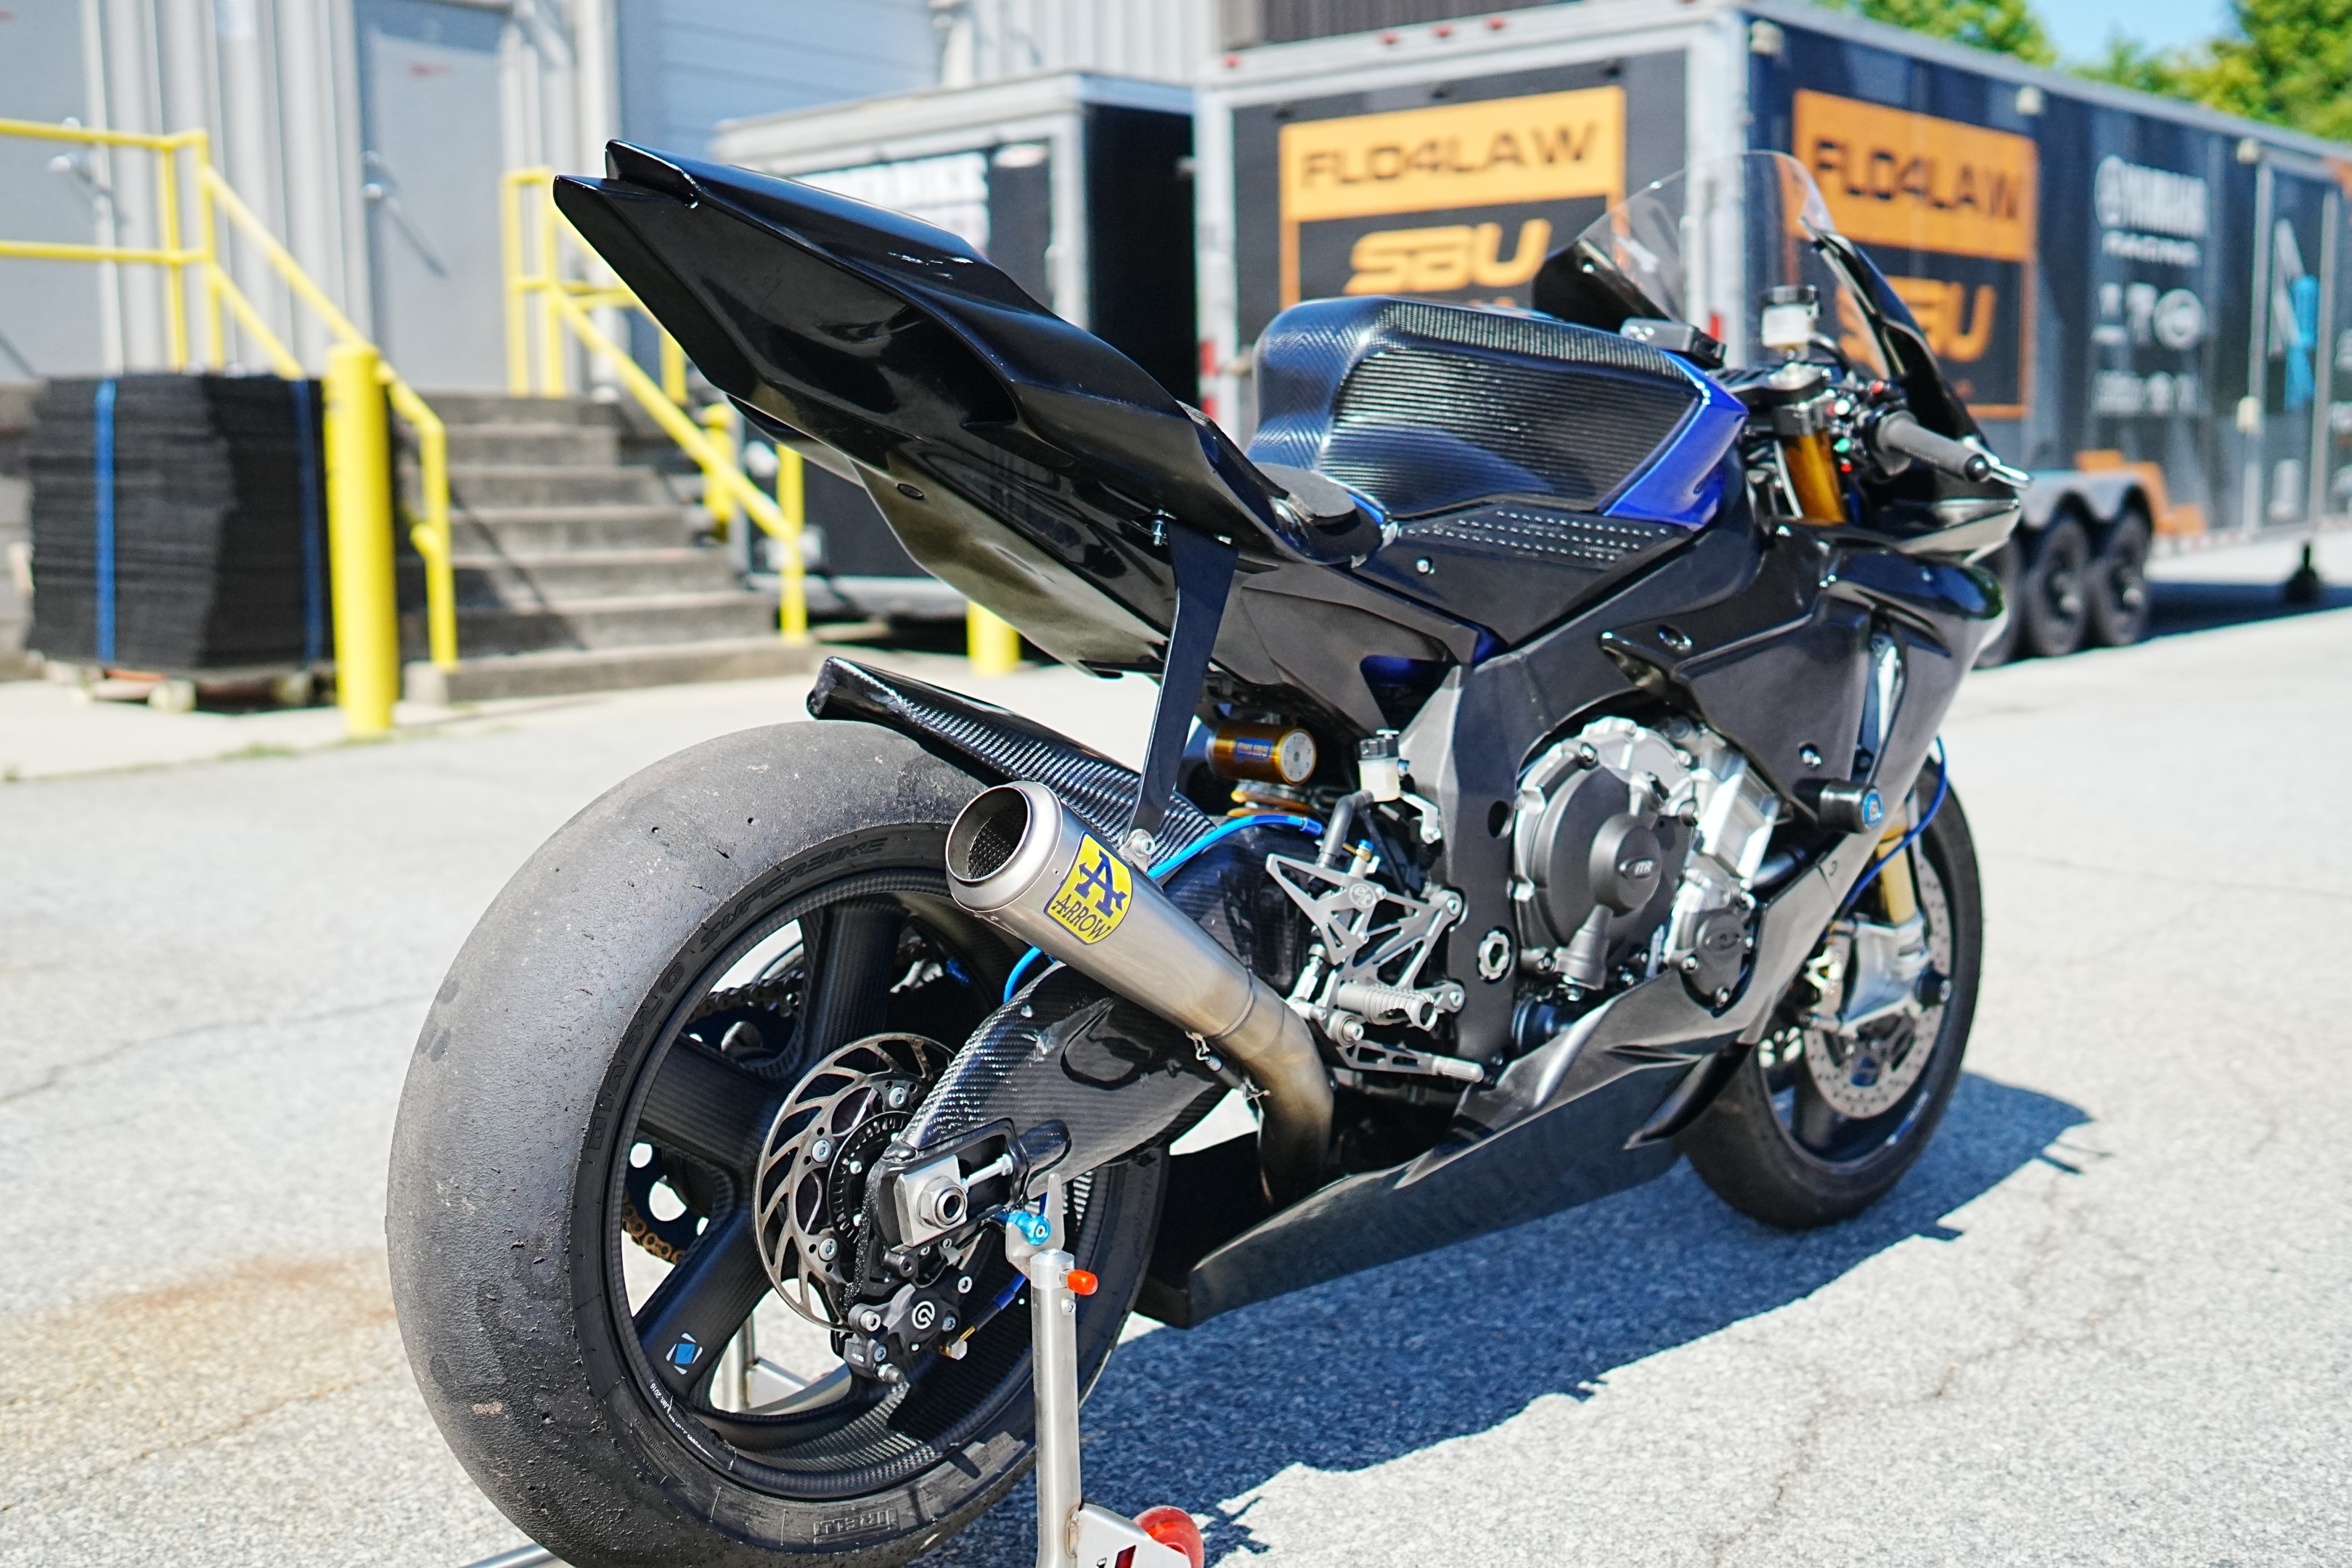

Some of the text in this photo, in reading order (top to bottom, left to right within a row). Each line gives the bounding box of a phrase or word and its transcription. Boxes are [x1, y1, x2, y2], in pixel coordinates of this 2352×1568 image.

[699, 836, 891, 952] SUPERBIKE
[1050, 893, 1112, 941] ARROW
[650, 1383, 661, 1398] 2016
